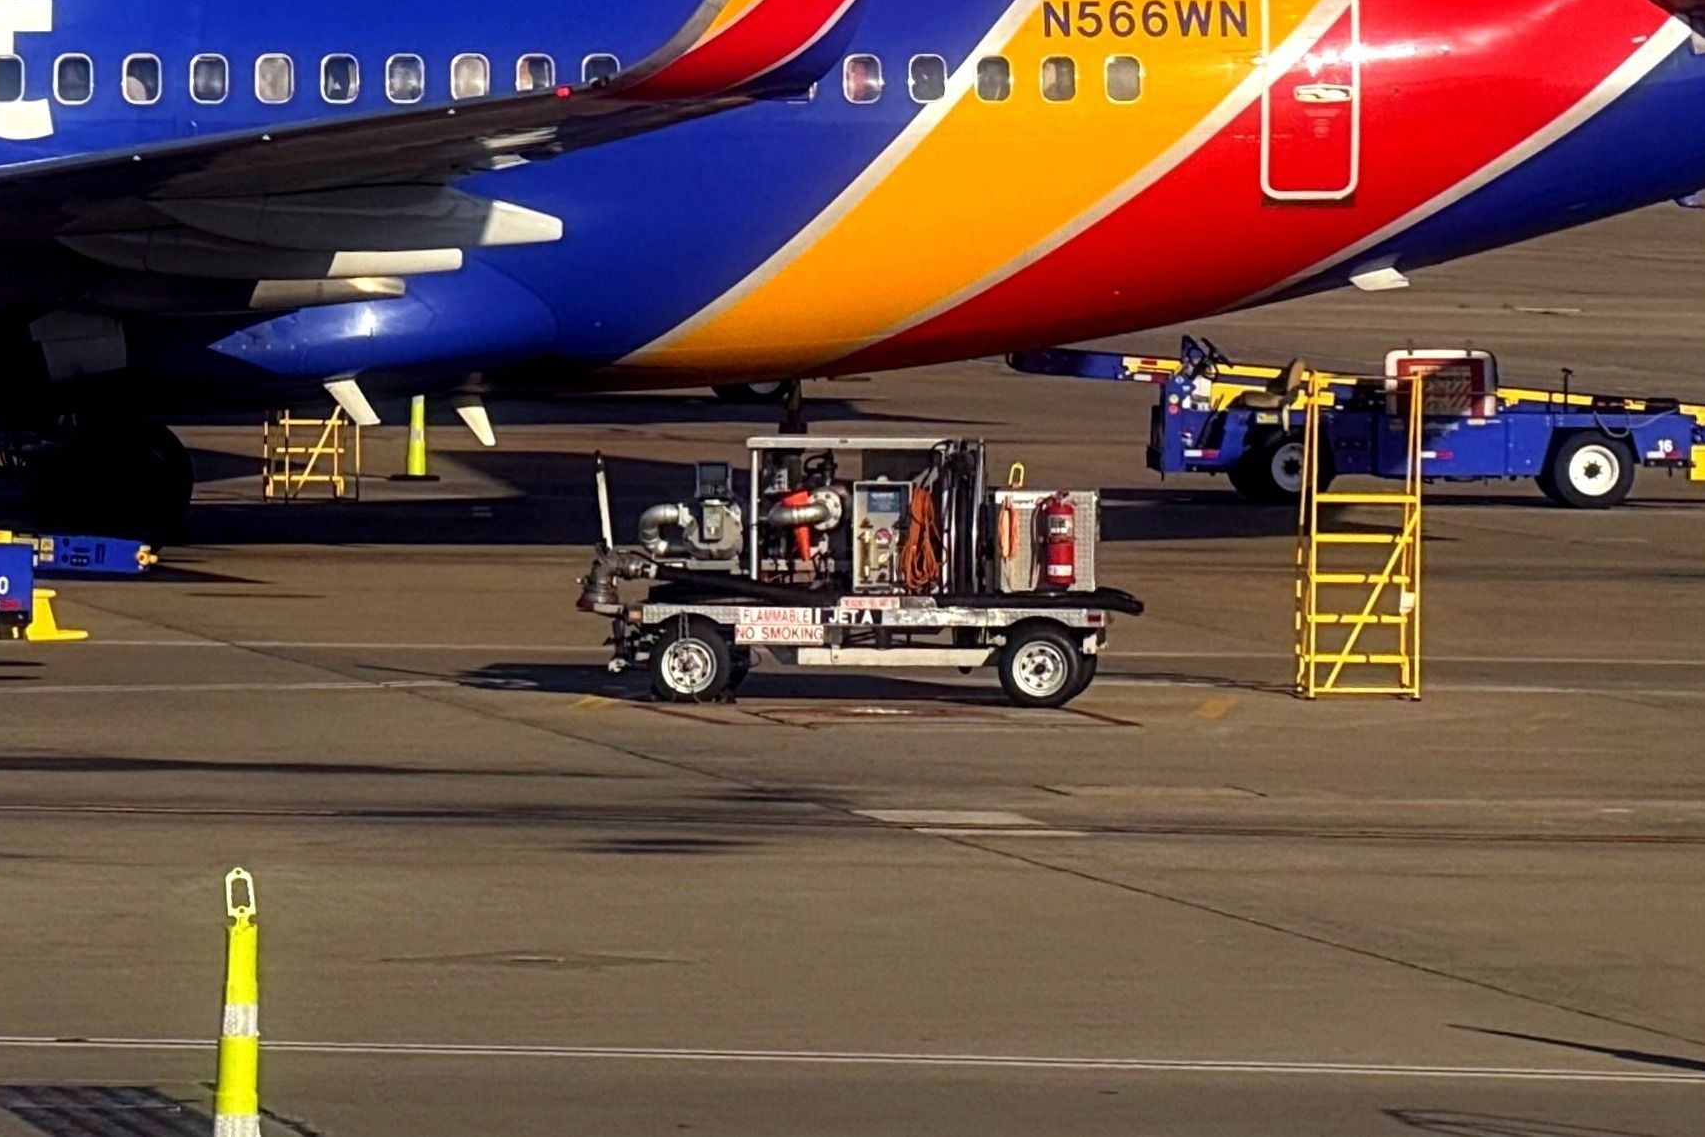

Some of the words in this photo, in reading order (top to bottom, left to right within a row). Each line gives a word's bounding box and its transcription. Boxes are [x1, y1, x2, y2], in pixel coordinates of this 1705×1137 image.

[1042, 0, 1248, 38] N566WN
[1658, 439, 1673, 453] 16
[744, 609, 809, 624] FLAMMABLE
[829, 610, 859, 624] JET
[861, 610, 873, 624] A
[736, 626, 755, 640] NO
[761, 626, 824, 640] SMOKING
